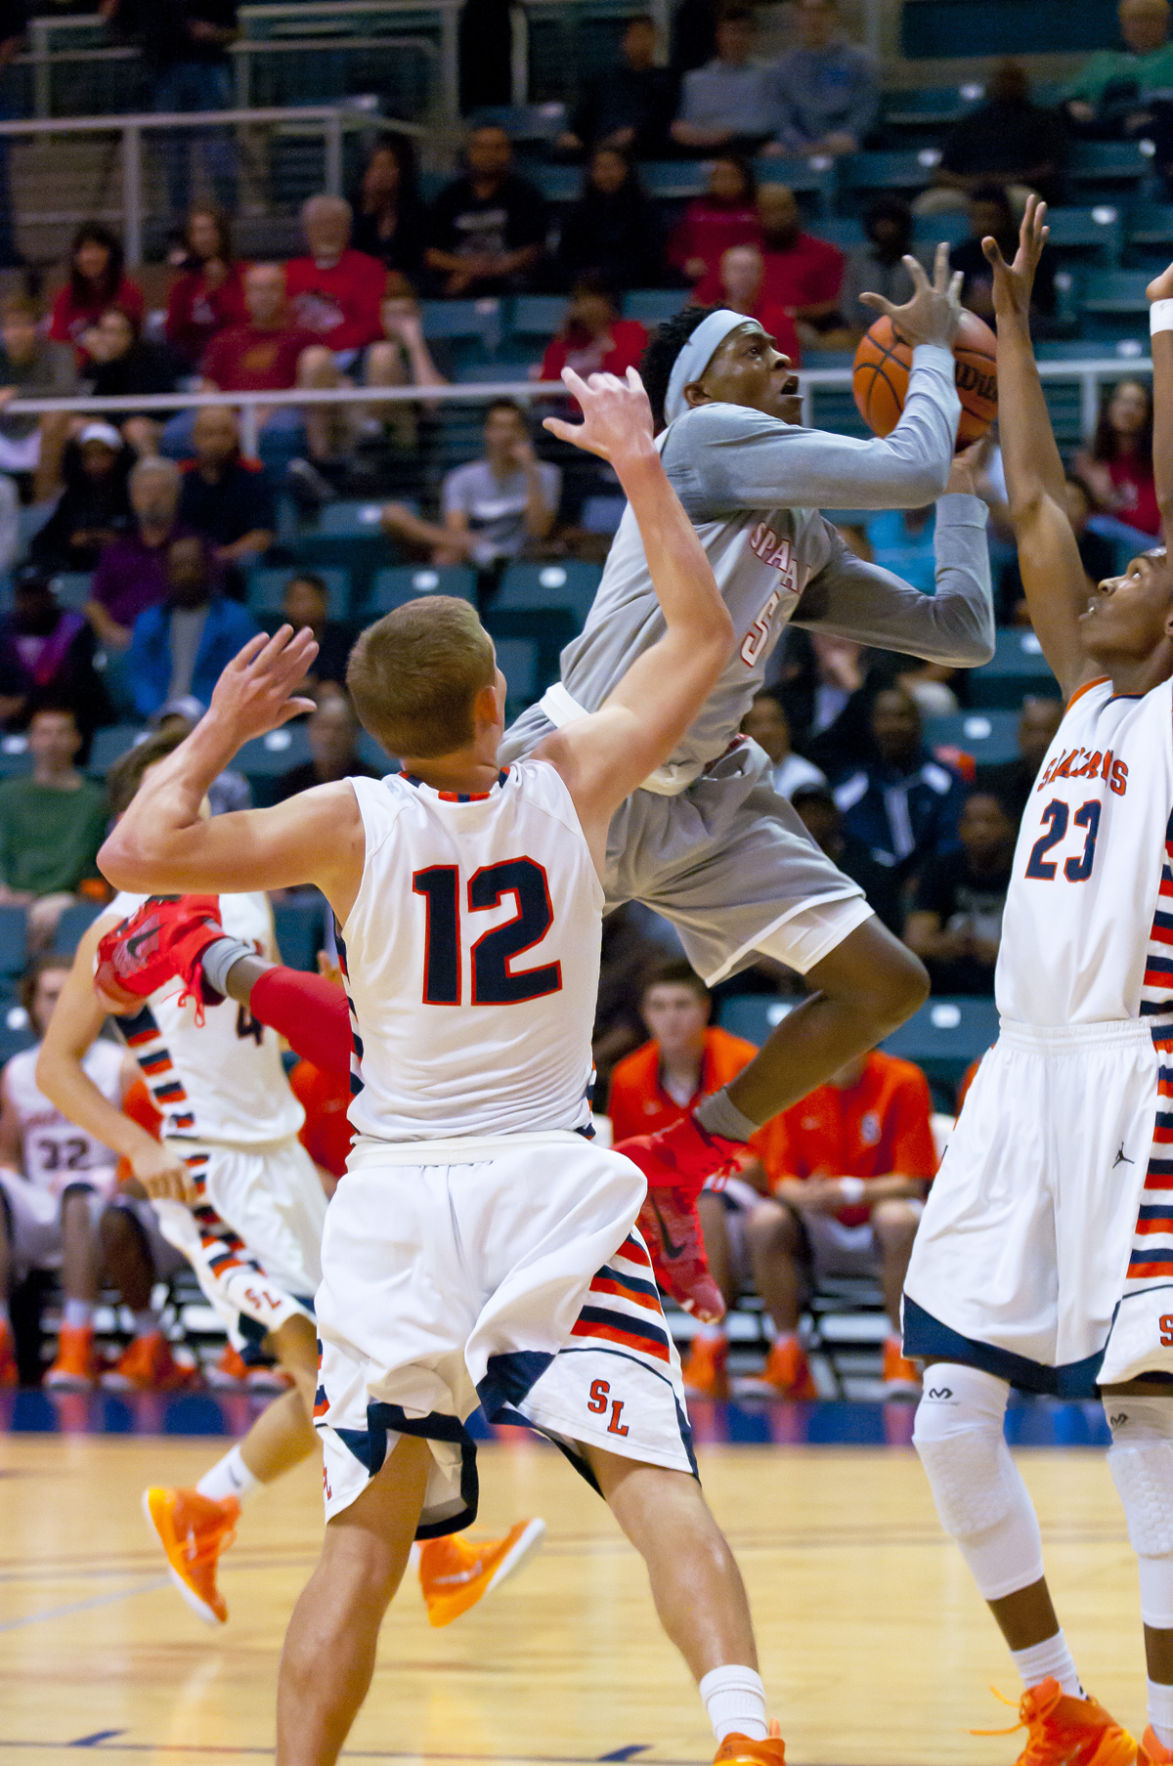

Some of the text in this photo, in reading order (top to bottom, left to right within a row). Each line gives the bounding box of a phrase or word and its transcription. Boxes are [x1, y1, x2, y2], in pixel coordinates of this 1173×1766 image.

[1024, 798, 1102, 883] 23
[412, 855, 562, 1006] 12
[587, 1378, 629, 1437] SL
